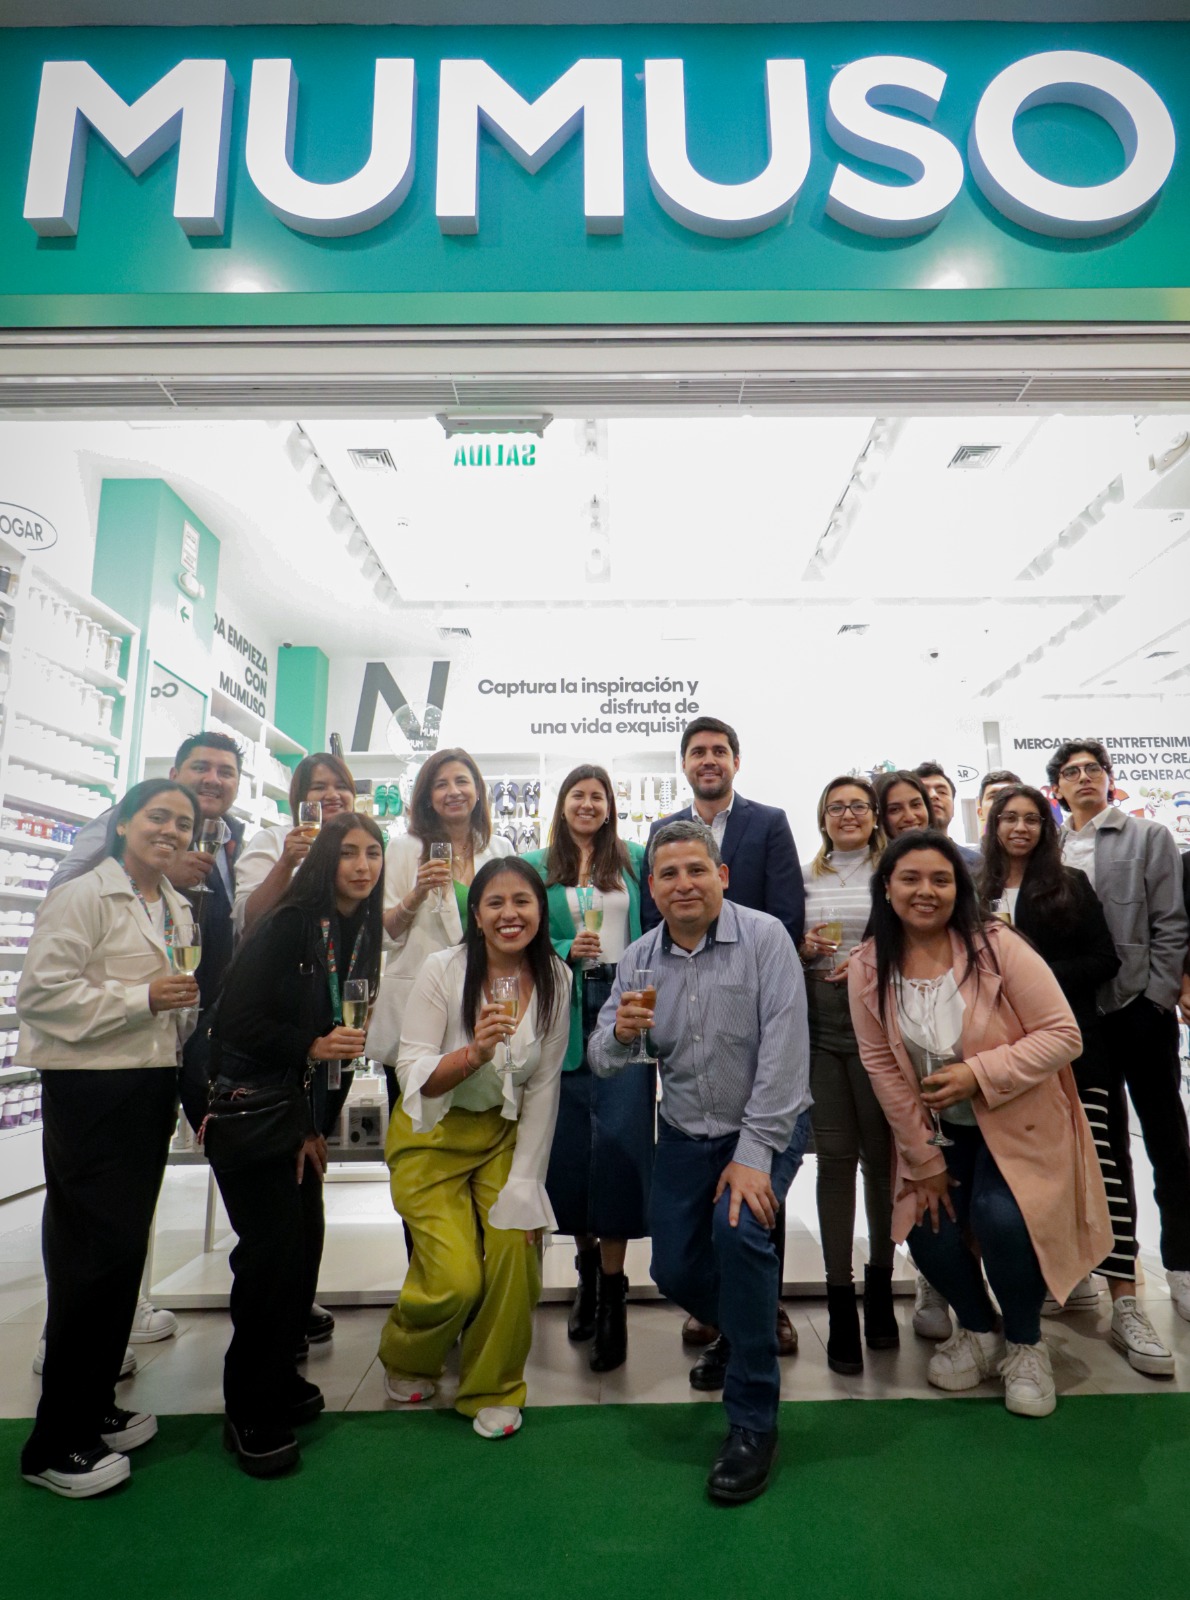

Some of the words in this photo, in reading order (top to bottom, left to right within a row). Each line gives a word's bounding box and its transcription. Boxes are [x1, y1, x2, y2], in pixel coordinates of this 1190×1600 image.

[23, 50, 1176, 237] MUMUSO
[228, 624, 268, 676] EMPIEZA
[245, 666, 267, 698] CON
[478, 679, 557, 698] Captura
[561, 678, 578, 694] la
[582, 677, 684, 696] inspiración
[687, 680, 699, 696] y
[220, 670, 266, 719] MUMUSO
[600, 698, 671, 714] disfruta
[674, 698, 700, 714] de
[531, 721, 567, 734] una
[570, 717, 612, 734] vida
[616, 716, 688, 736] exquisit
[1106, 736, 1190, 748] ENTRETENIM
[1110, 752, 1147, 764] ERNO
[1149, 753, 1158, 764] Y
[1161, 752, 1190, 764] CRE
